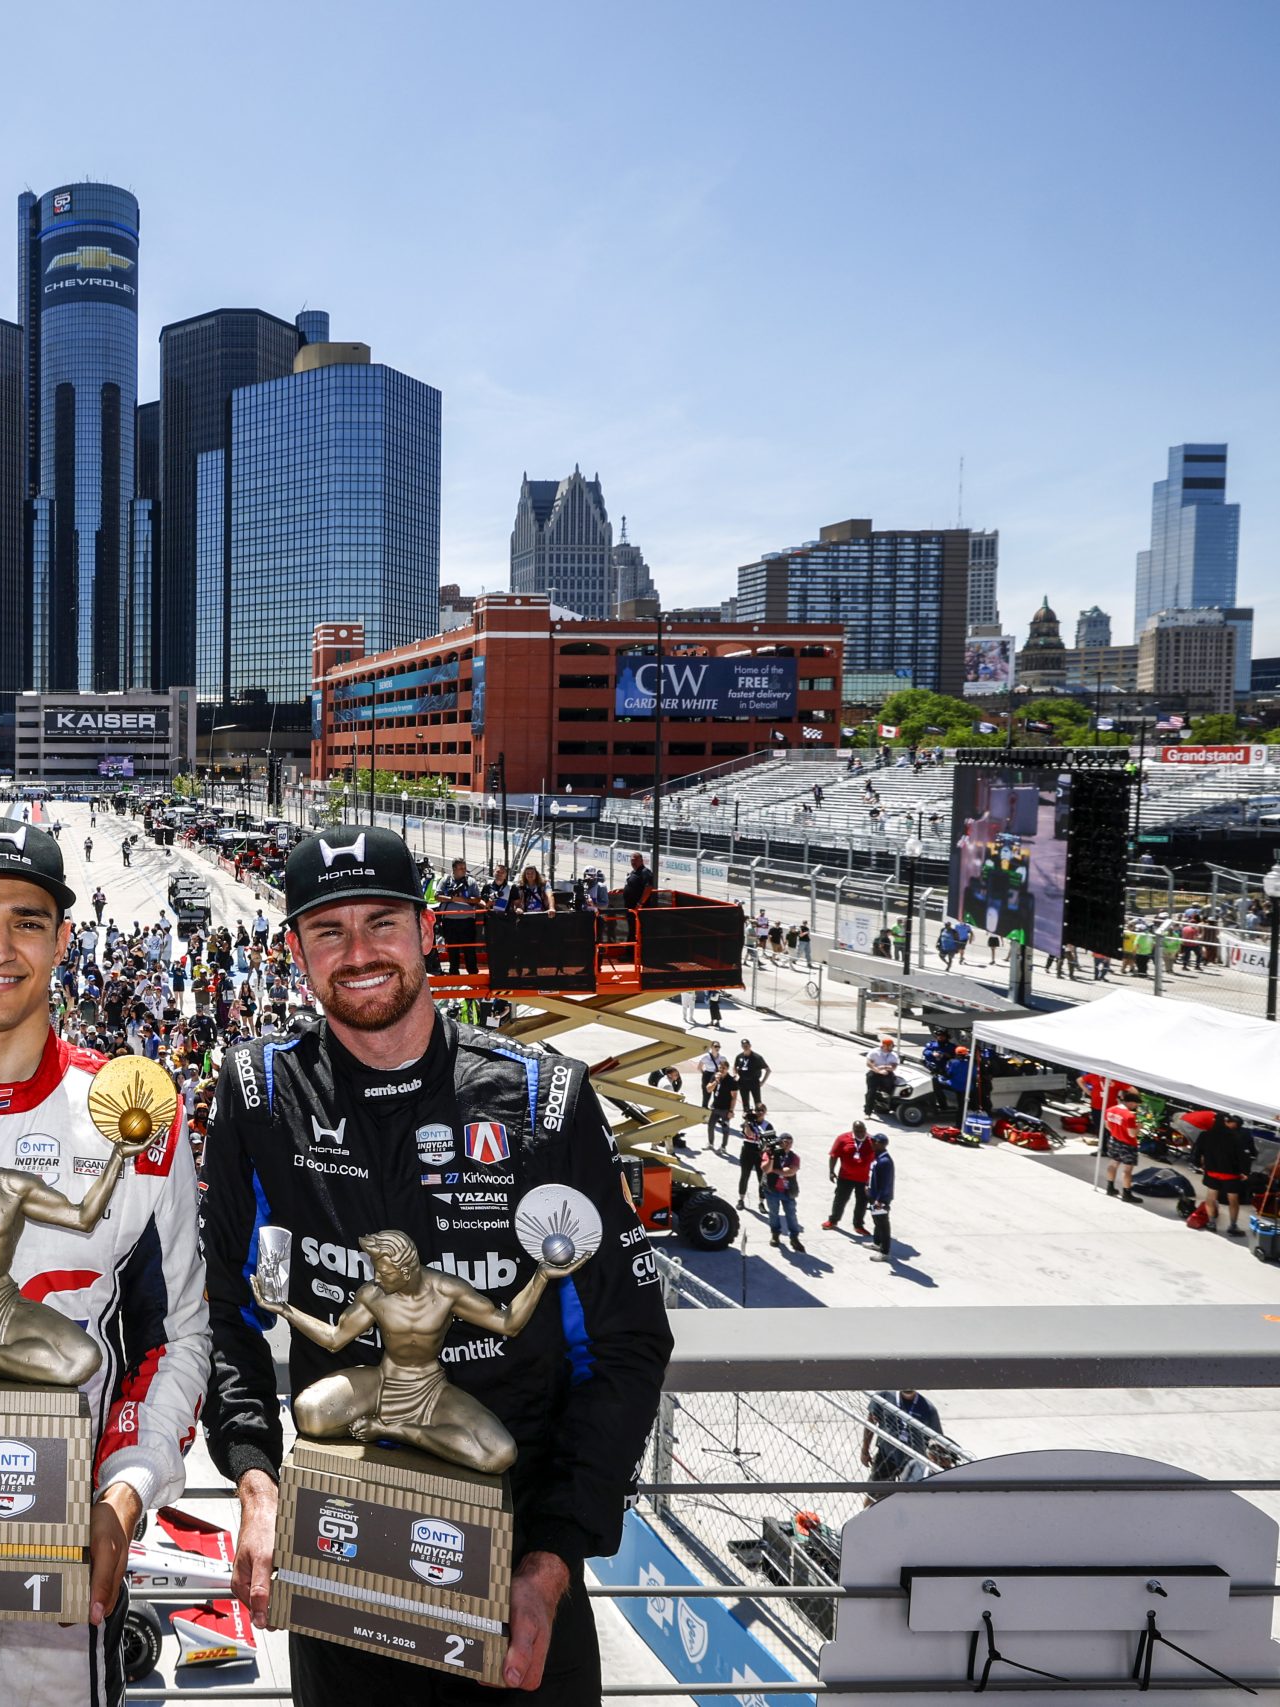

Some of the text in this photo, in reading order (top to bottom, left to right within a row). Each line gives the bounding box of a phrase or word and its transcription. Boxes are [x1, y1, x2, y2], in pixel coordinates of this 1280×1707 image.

[44, 277, 137, 296] CHEVROLET
[734, 664, 784, 674] Home of the
[635, 663, 710, 697] GW
[738, 676, 769, 689] FREE
[728, 689, 792, 700] fastest delivery
[624, 697, 719, 711] GARDNER WHITE
[740, 701, 778, 709] in Detroit!
[57, 713, 156, 728] KAISER
[1167, 749, 1244, 762] Grandstand
[1254, 750, 1263, 760] 9
[318, 867, 375, 883] Honda
[1243, 953, 1269, 968] LEA
[236, 1049, 261, 1110] sparco
[398, 1077, 423, 1094] club
[543, 1065, 570, 1132] sparco
[430, 1130, 448, 1138] NTT
[32, 1143, 55, 1153] NTT
[309, 1145, 350, 1156] Honda
[417, 1140, 454, 1150] INDYCAR
[15, 1157, 60, 1166] INDYCAR
[306, 1158, 369, 1179] GOLD.COM
[444, 1171, 515, 1185] 27 Kirkwood
[454, 1192, 508, 1203] YAZAKI
[452, 1217, 510, 1231] blackpoint
[440, 1336, 506, 1363] anttik
[0, 1454, 30, 1467] NTT
[319, 1508, 360, 1521] DETROIT
[318, 1515, 359, 1541] GP
[432, 1532, 459, 1545] NTT
[410, 1542, 464, 1563] INDYCAR
[420, 1554, 451, 1566] SERIES
[353, 1626, 416, 1649] MAY 31, 2026
[193, 1648, 230, 1660] DHL
